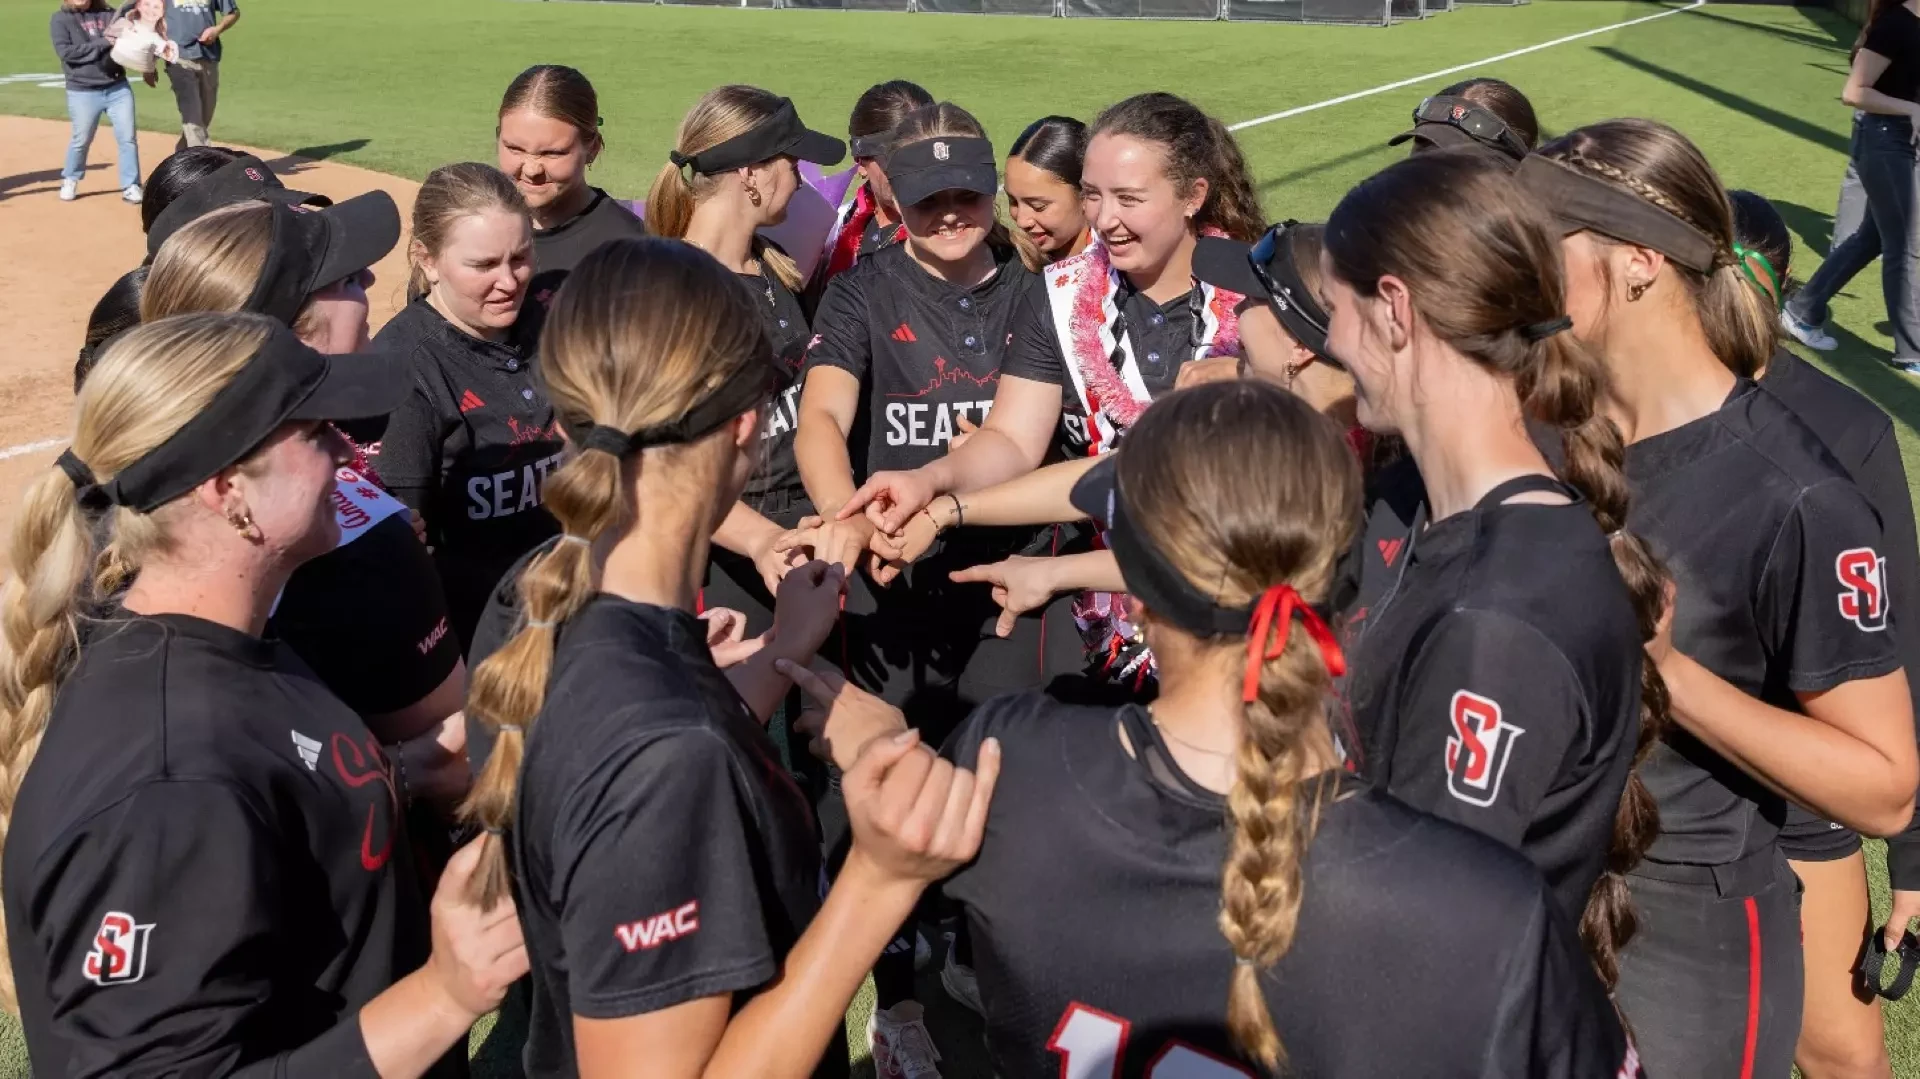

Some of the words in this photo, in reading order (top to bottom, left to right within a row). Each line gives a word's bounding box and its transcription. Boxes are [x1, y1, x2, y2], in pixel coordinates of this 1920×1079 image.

[416, 615, 448, 655] WAC
[1445, 689, 1526, 807] SU
[615, 898, 699, 953] WAC
